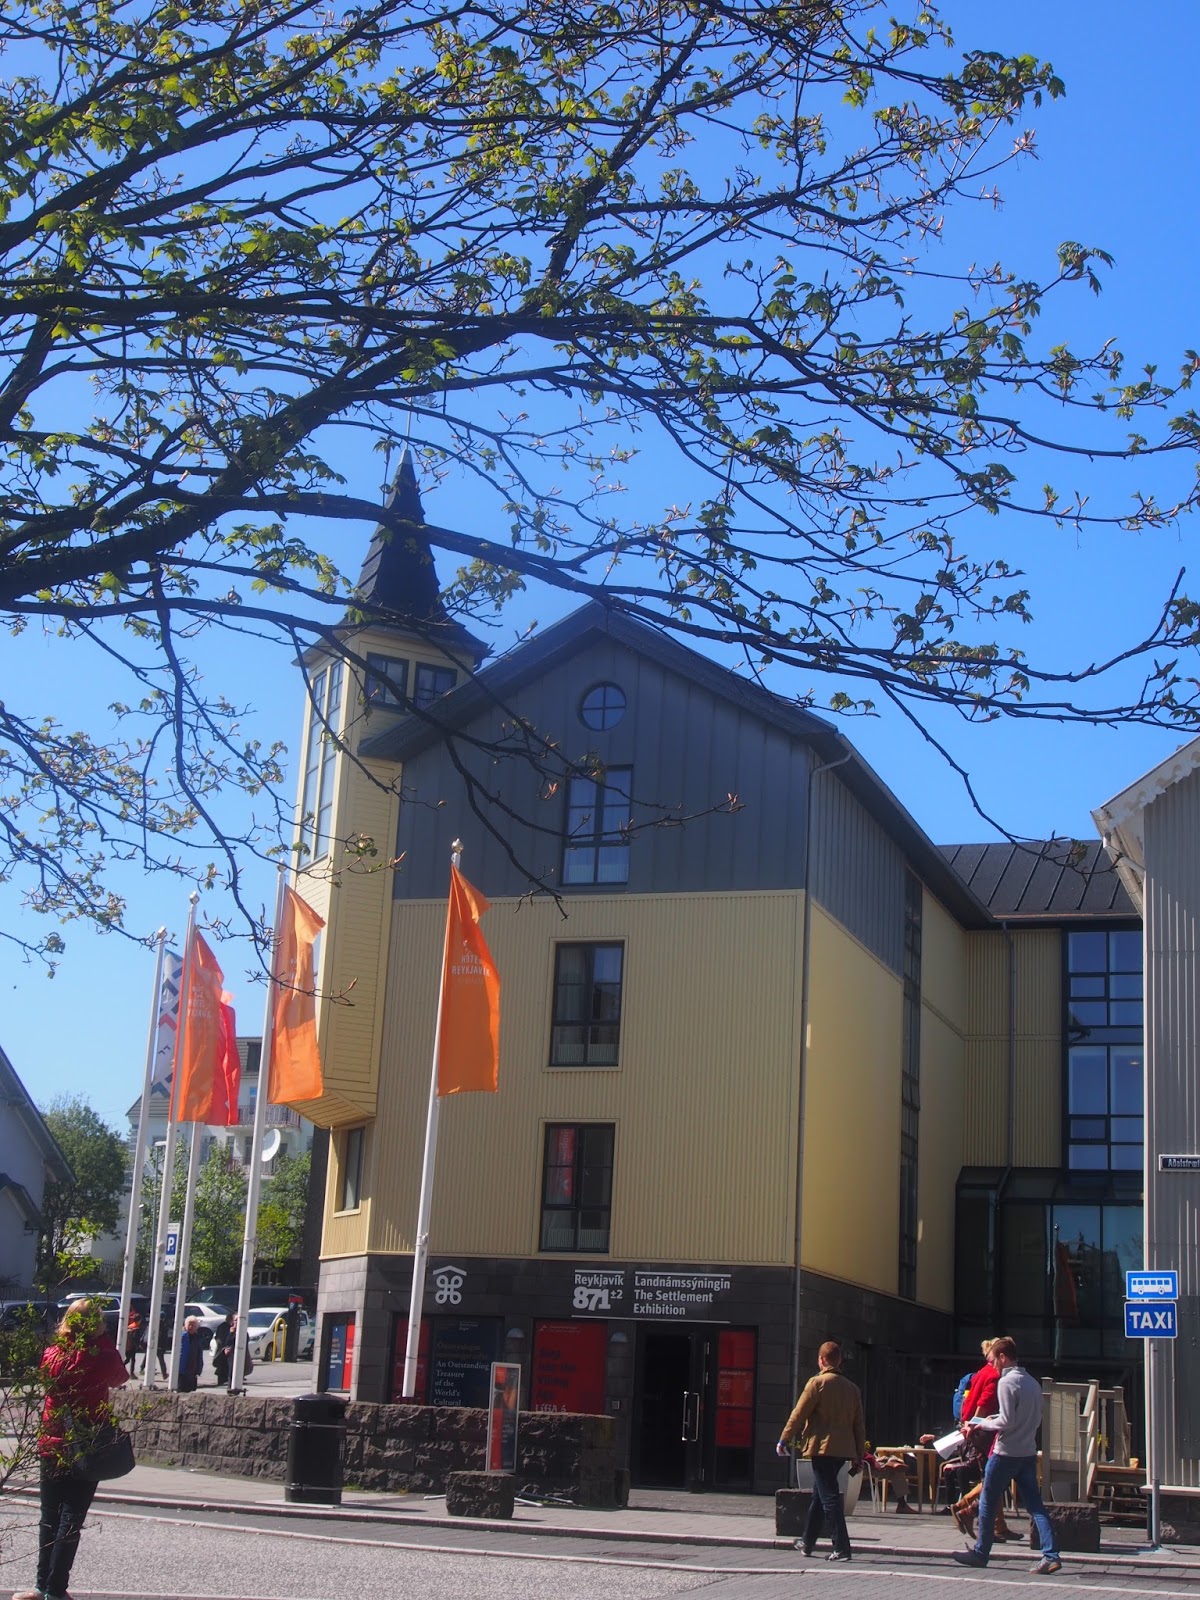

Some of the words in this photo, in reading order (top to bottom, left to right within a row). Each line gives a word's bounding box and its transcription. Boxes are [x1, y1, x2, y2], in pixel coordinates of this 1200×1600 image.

[167, 1236, 175, 1252] P
[574, 1274, 624, 1287] Reykjavík
[634, 1275, 731, 1291] Landnámssýningin
[634, 1289, 653, 1300] The
[655, 1290, 713, 1302] Settlement
[633, 1303, 686, 1315] Exhibition
[1129, 1311, 1173, 1329] TAXI
[447, 1361, 490, 1371] Outstanding
[436, 1370, 465, 1378] Treasure
[443, 1379, 454, 1387] the
[434, 1388, 460, 1397] World's
[433, 1398, 462, 1406] Cultural
